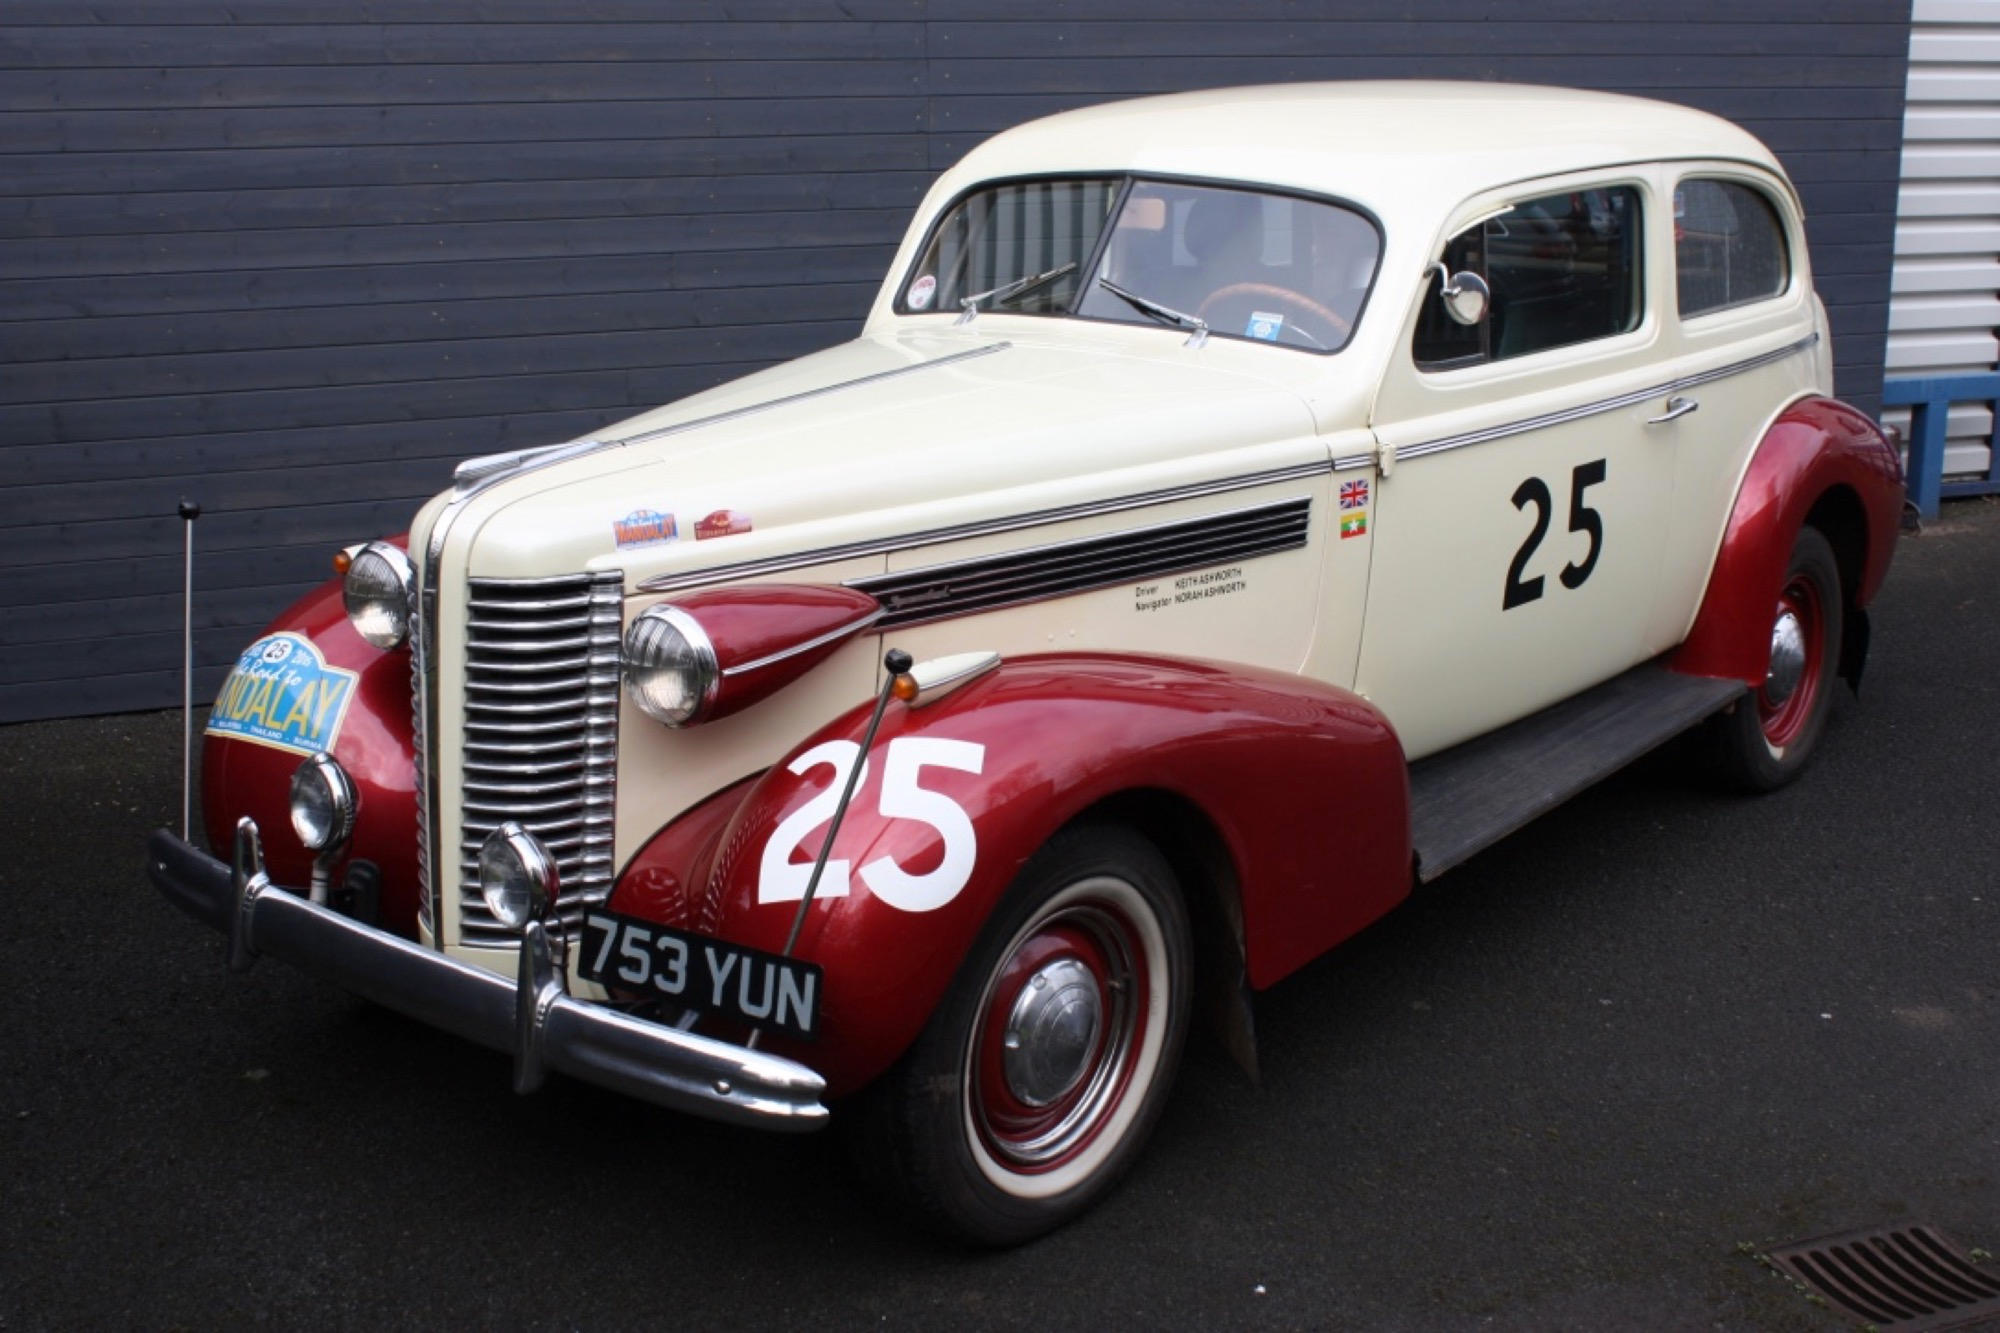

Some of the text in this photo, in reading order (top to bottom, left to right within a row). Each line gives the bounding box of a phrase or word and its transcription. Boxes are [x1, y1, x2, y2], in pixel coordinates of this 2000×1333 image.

[1502, 458, 1606, 612] 25
[1136, 568, 1242, 597] Driver KEITH ASHWORTH
[1136, 581, 1246, 612] Navigator NORAH ASHWORTH
[266, 642, 289, 658] 25
[757, 736, 986, 913] 25
[588, 916, 816, 1032] 753 YUN
